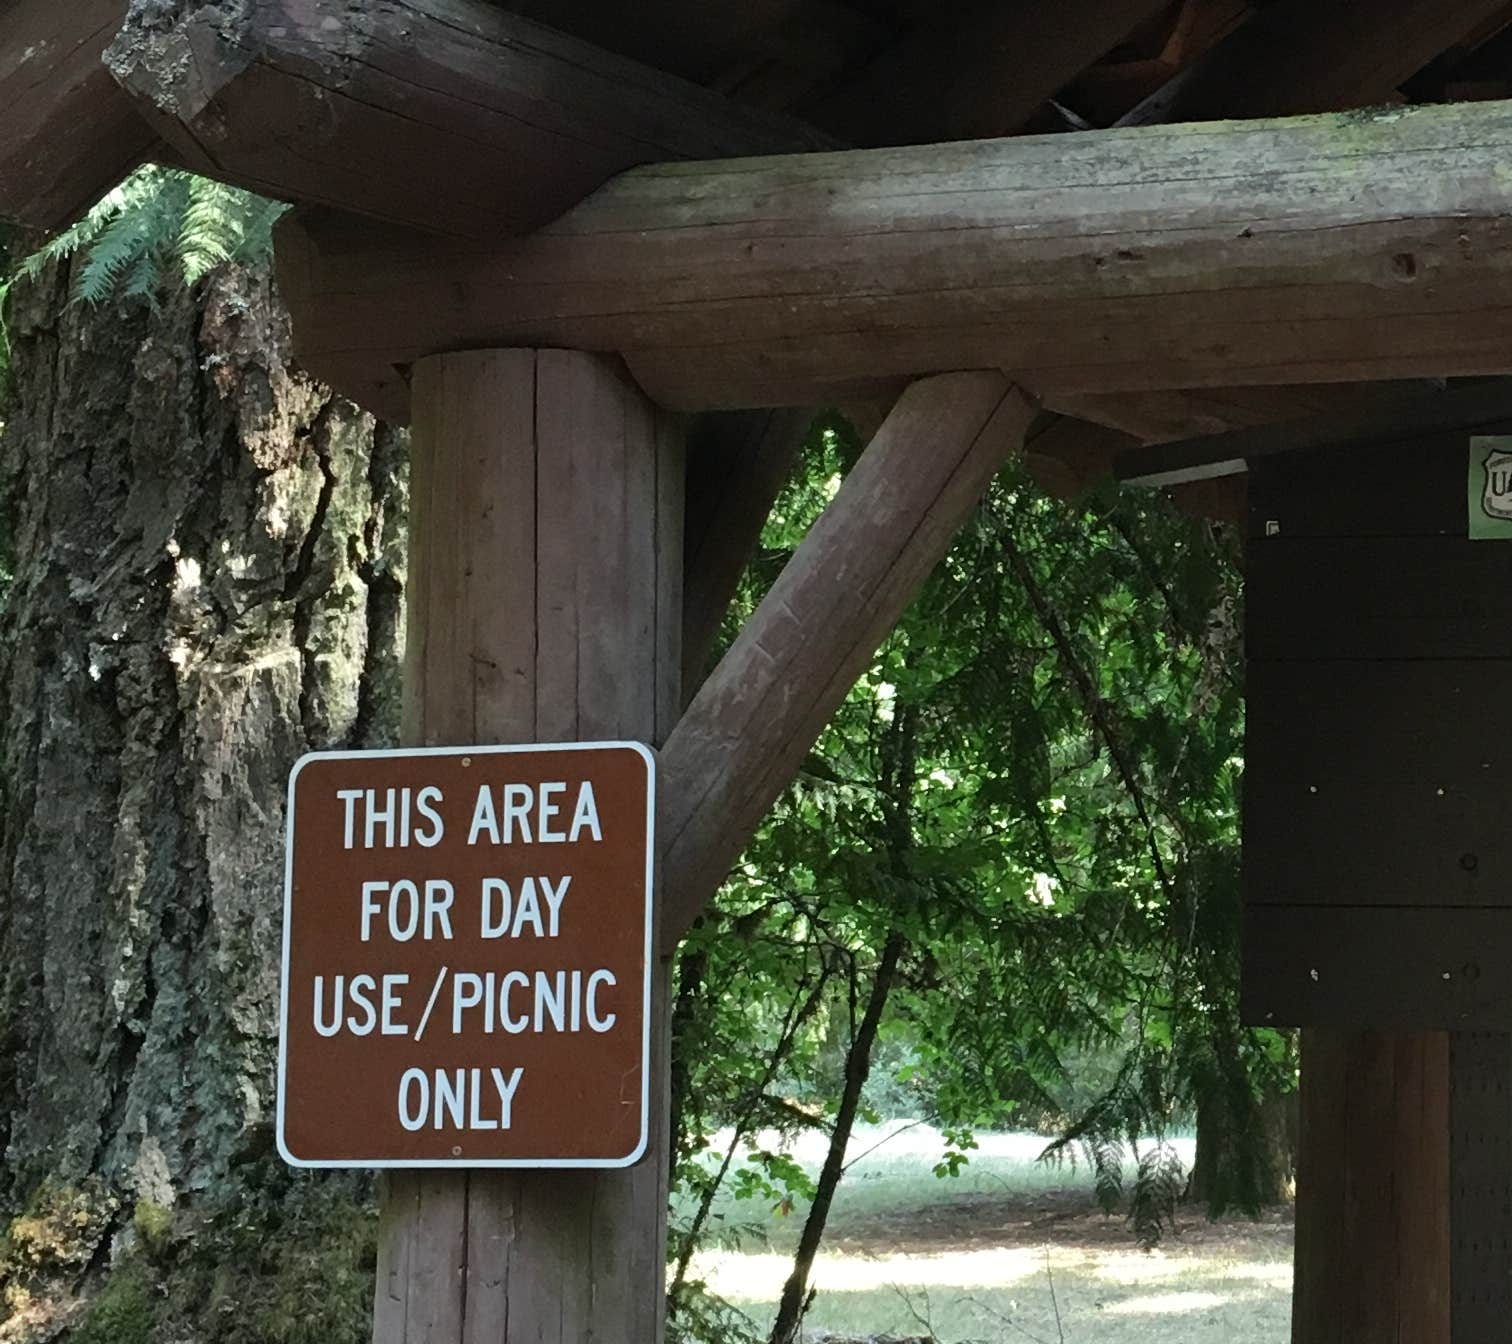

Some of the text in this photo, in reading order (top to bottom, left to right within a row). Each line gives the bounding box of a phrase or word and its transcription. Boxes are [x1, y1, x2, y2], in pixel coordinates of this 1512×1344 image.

[337, 781, 603, 849] THIS AREA
[361, 876, 572, 941] FOR DAY
[313, 966, 617, 1042] USE/PICNIC
[398, 1068, 524, 1130] ONLY
